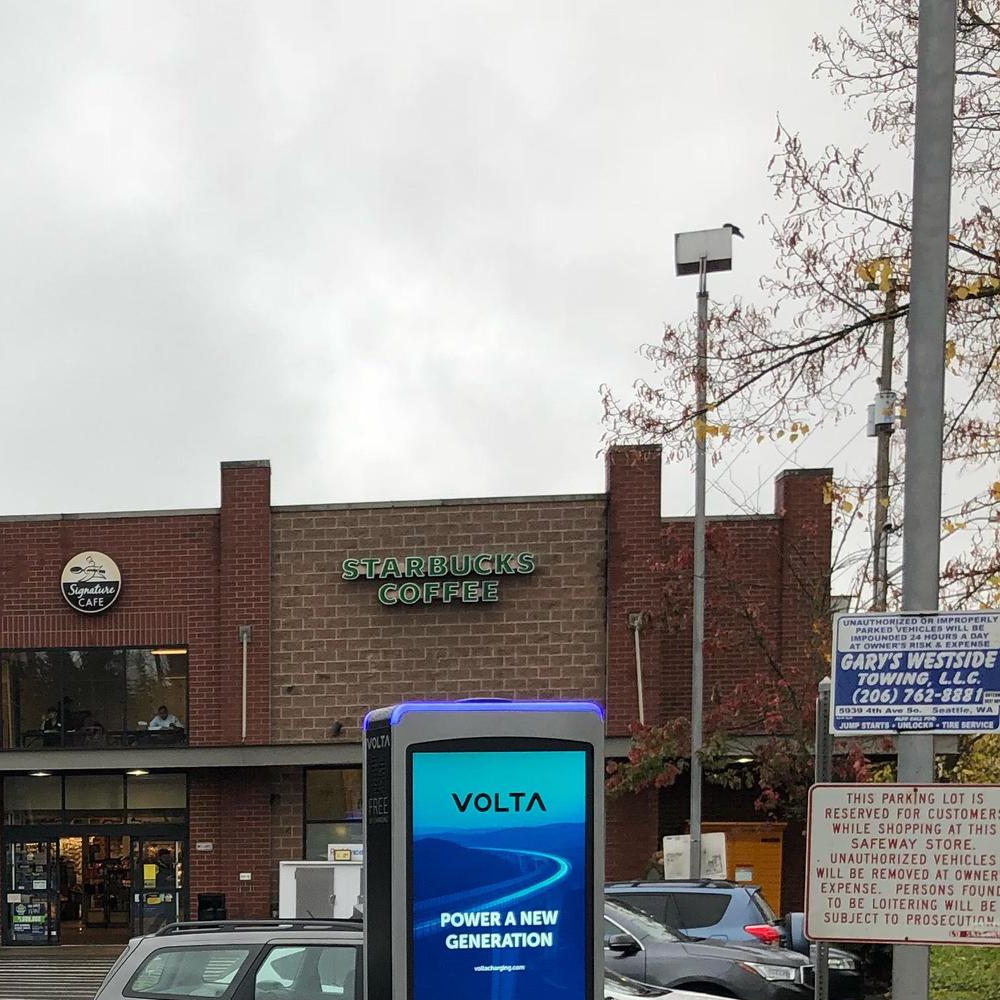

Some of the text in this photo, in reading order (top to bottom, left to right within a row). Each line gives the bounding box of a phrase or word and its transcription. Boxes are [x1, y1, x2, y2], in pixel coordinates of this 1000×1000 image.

[342, 552, 535, 580] STARBUCKS
[68, 583, 116, 599] Signature
[378, 580, 499, 606] COFFEE
[78, 597, 104, 607] CAFE
[843, 619, 918, 627] UNAUTHORIZED
[936, 616, 998, 624] IMPROPERLY
[855, 626, 893, 634] PARKED
[895, 625, 943, 633] VEHICLES
[972, 624, 985, 632] BE
[850, 634, 907, 642] IMPOUNDED
[970, 632, 989, 640] DAY
[945, 640, 990, 648] EXPENSE
[840, 651, 998, 671] GARY'S WESTSIDE
[857, 671, 981, 687] TOWING, L.L.C.
[852, 688, 898, 704] (206)
[903, 687, 984, 703] 762-8881
[838, 706, 863, 714] 5939
[866, 706, 882, 714] 4th
[885, 706, 903, 714] Ave
[906, 706, 922, 714] So.
[932, 706, 973, 715] Seattle,
[839, 721, 860, 729] JUMP
[861, 721, 890, 729] STARTS
[942, 721, 959, 729] TIRE
[961, 721, 993, 729] SERVICE
[367, 734, 391, 750] VOLTA
[451, 792, 547, 813] VOLTA
[847, 792, 984, 805] THIS PARKING LOT IS
[825, 808, 1000, 820] RESERVED FOR CUSTOMER
[832, 823, 996, 835] WHILE SHOPPING AT THIS
[851, 838, 976, 850] SAFEWAY STORE.
[830, 853, 996, 866] UNAUTHORIZED VEHICLES
[816, 867, 843, 879] WILL
[850, 868, 865, 879] BE
[871, 868, 929, 880] REMOVED
[935, 869, 949, 880] AT
[820, 882, 882, 894] EXPENSE.
[896, 883, 954, 896] PERSONS
[827, 897, 997, 912] TO BE LOITERING WILL BE
[440, 910, 559, 928] POWER A NEW
[823, 912, 999, 927] SUBJECT TO PROSECUTION.
[445, 932, 553, 949] GENERATION
[474, 964, 526, 972] voltacharging.com
